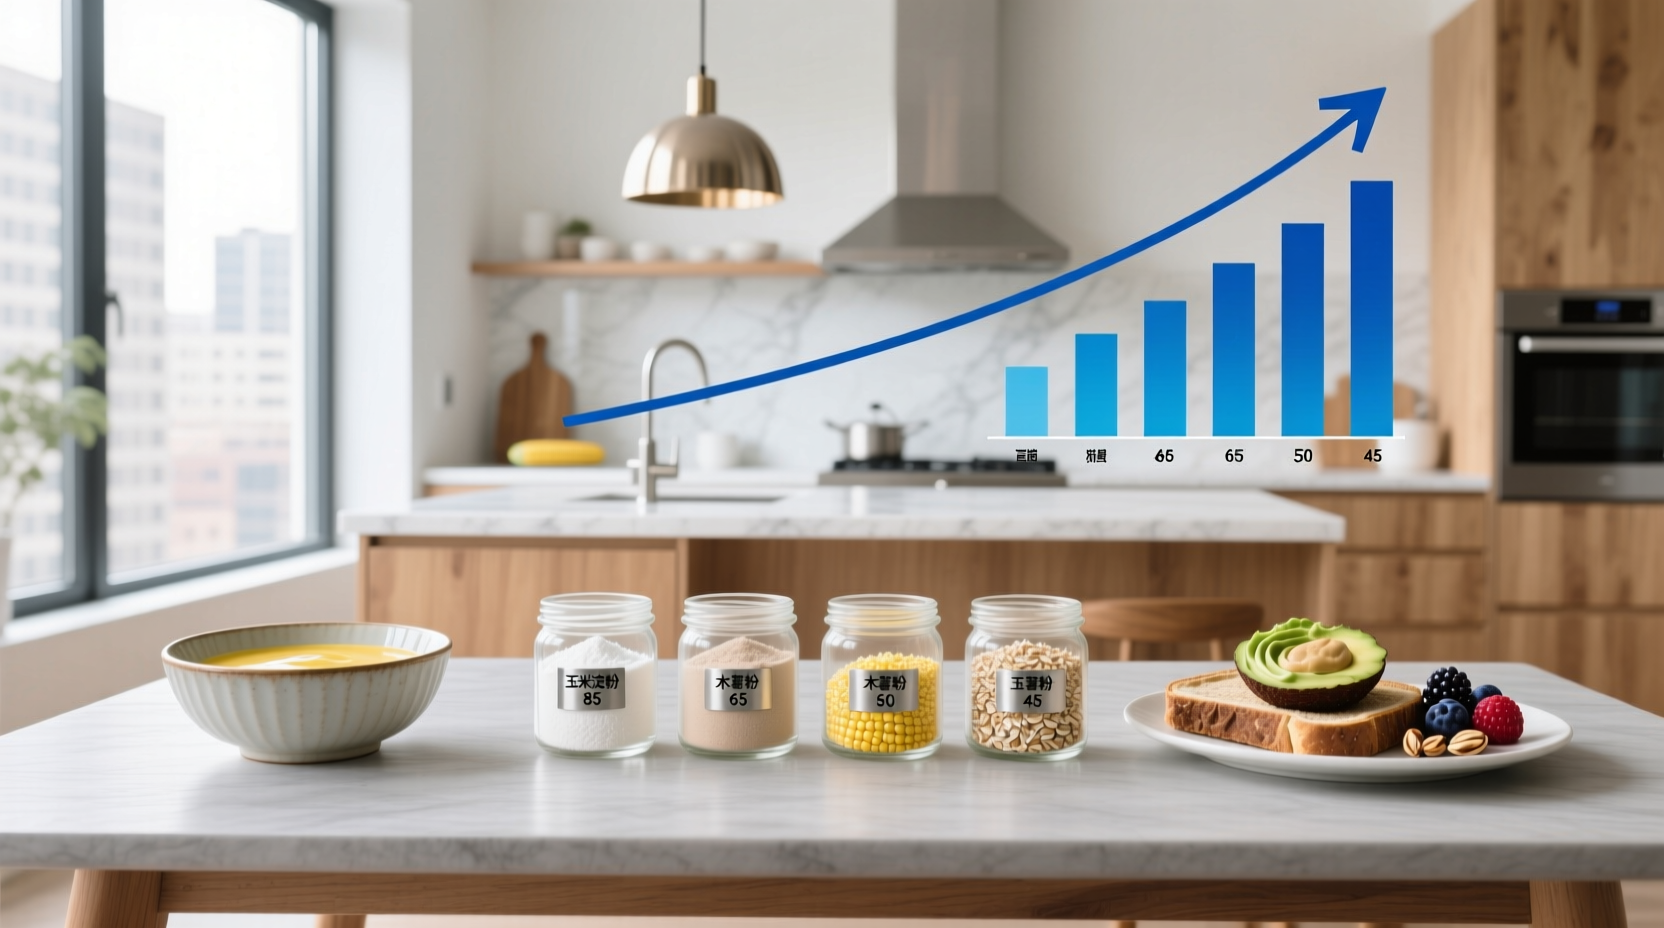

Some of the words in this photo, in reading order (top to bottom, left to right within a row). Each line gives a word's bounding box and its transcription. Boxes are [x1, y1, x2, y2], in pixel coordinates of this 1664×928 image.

[583, 692, 602, 705] 85
[729, 692, 748, 706] 65
[1023, 694, 1043, 708] 45
